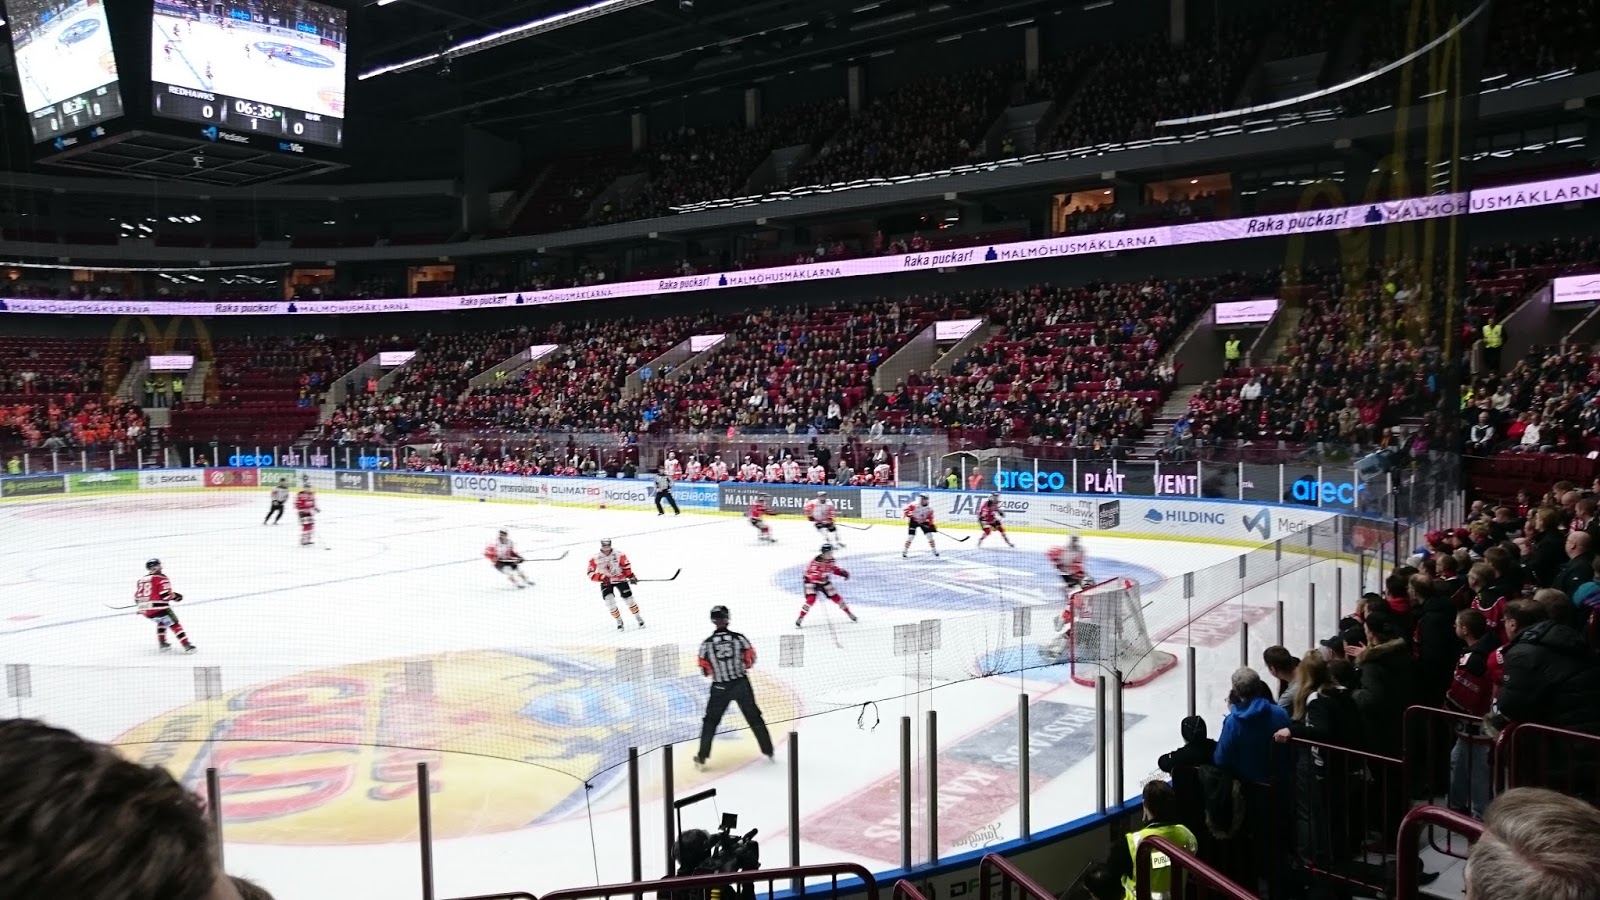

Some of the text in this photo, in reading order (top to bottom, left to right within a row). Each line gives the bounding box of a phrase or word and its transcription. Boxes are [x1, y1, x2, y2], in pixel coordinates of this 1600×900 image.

[168, 86, 215, 101] REDHAWKS
[203, 106, 214, 118] 0
[235, 101, 275, 119] 06:38
[250, 119, 258, 130] 1
[293, 123, 304, 135] 0
[1247, 210, 1348, 234] Raka puckar!
[1001, 236, 1157, 259] MALMÖHUSMÄKLARNA
[903, 249, 973, 268] Raka puckar!
[658, 276, 710, 291] Raka puckar!
[729, 268, 842, 286] MALMÖHUSMÄKLARNA
[215, 303, 278, 314] Raka puckar!
[454, 476, 497, 491] areco
[993, 469, 1065, 491] areco
[1084, 468, 1126, 493] PLÅT
[1153, 474, 1198, 495] VENT
[604, 490, 646, 501] Nordea
[672, 491, 718, 502] RENBORG
[949, 495, 989, 515] JAT
[1050, 503, 1094, 518] madhawk
[1166, 510, 1226, 525] HILDING
